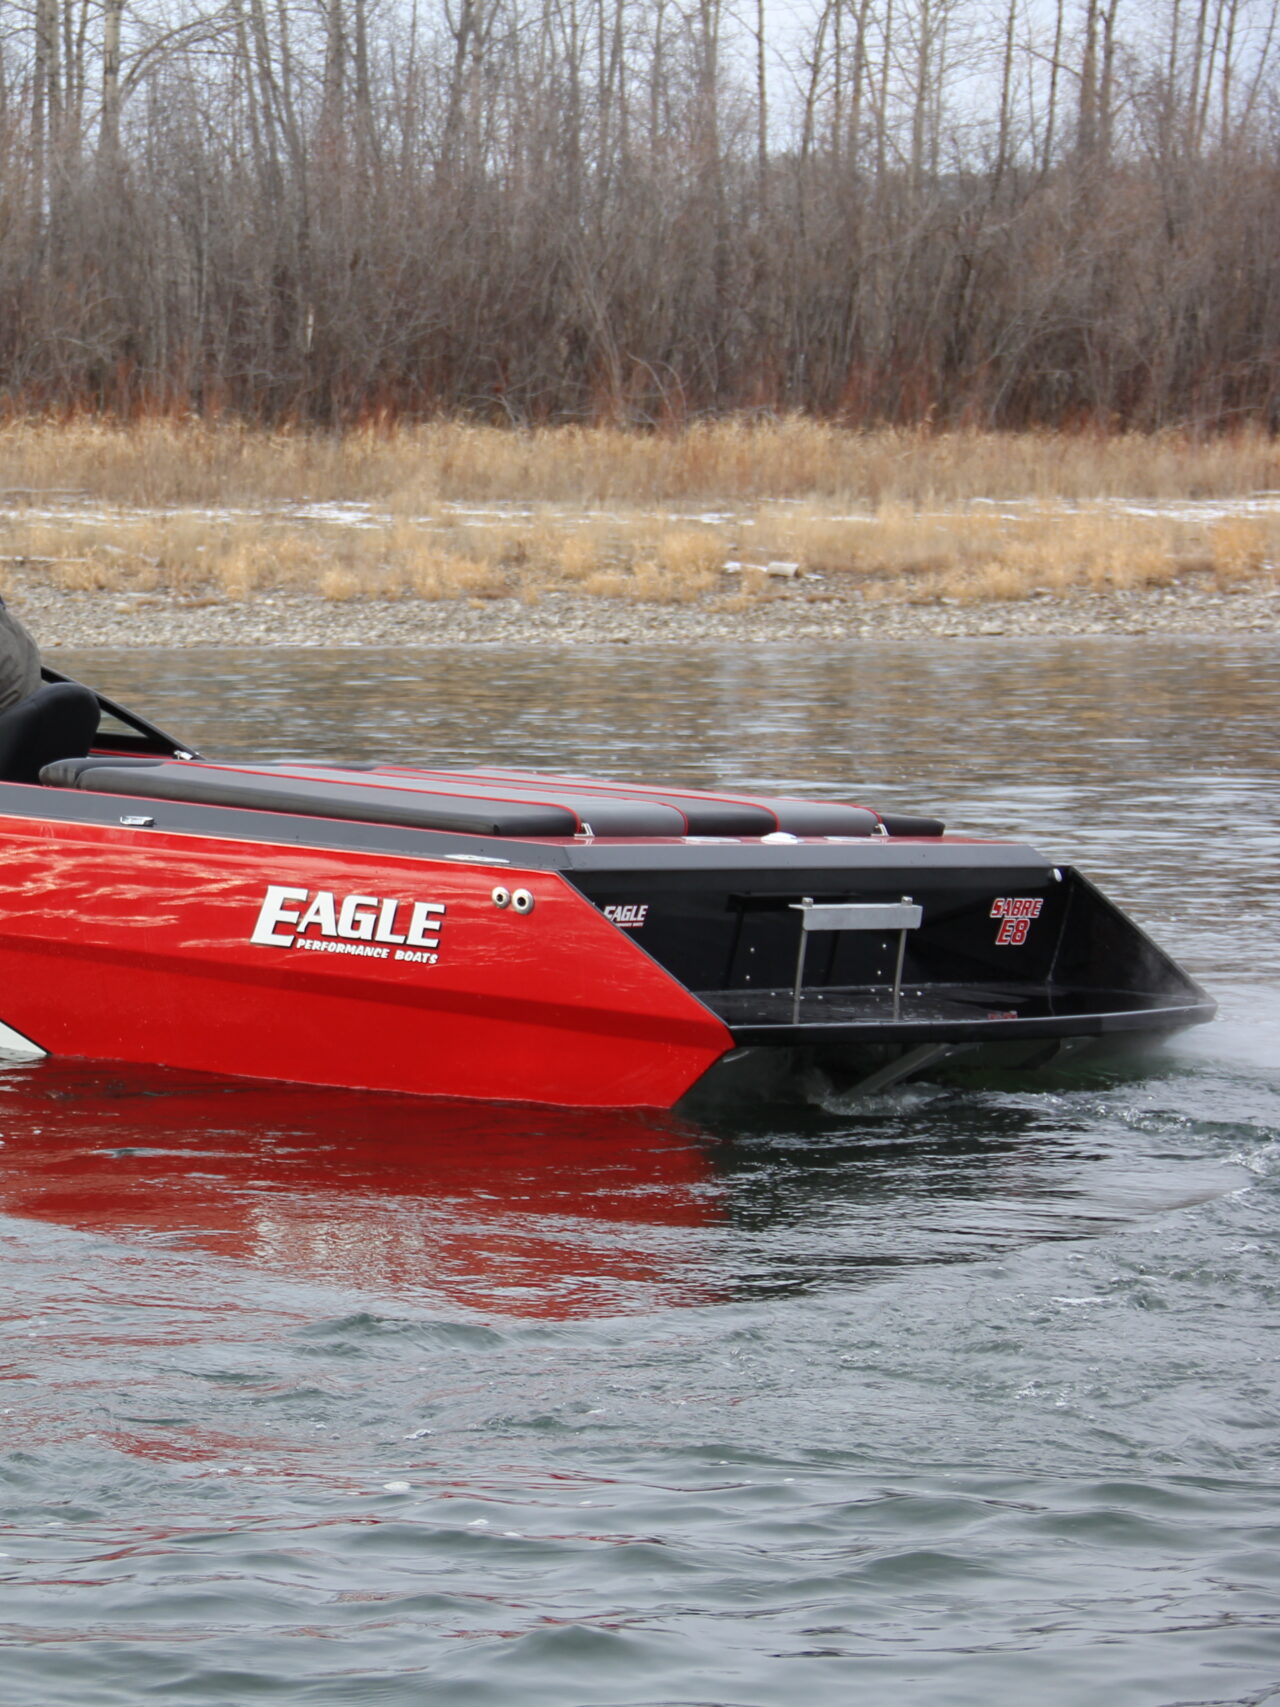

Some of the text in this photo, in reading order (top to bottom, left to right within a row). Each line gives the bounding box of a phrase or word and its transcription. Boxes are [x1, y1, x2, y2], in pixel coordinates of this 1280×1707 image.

[250, 885, 446, 949] EAGLE
[603, 905, 649, 921] EAGLE
[990, 898, 1044, 918] SABRE
[995, 919, 1030, 945] E8
[296, 938, 439, 965] PERFORMANCE BOATS
